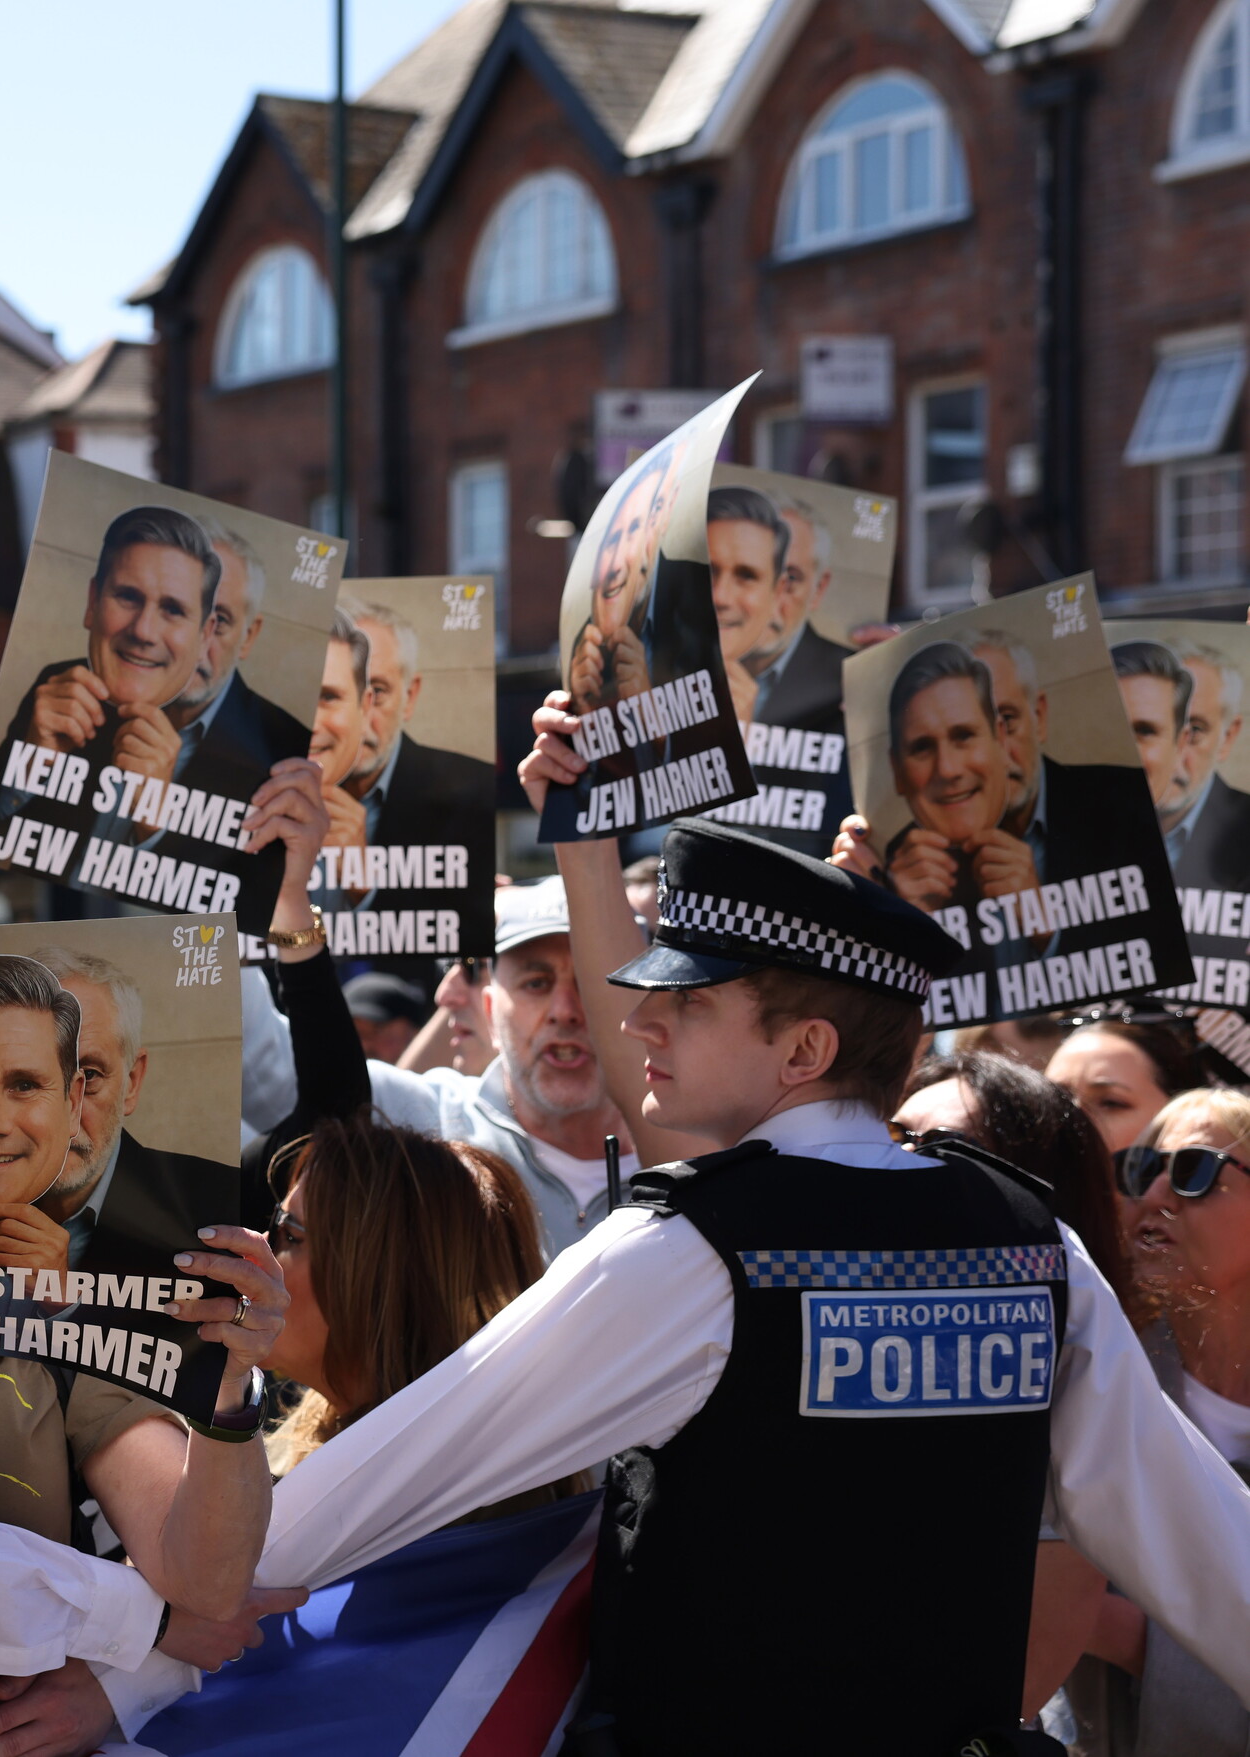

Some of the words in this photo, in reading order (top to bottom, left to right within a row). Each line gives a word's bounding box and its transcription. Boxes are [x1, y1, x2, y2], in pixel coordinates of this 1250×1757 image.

[299, 553, 329, 573] THE
[291, 566, 329, 589] HATE
[447, 599, 479, 616] THE
[1052, 603, 1082, 622] THE
[442, 614, 482, 631] HATE
[1052, 614, 1088, 640] HATE
[617, 669, 719, 748] STARMER
[738, 720, 845, 774] RMER
[2, 739, 90, 806] KEIR
[576, 776, 636, 834] JEW
[639, 747, 735, 820] HARMER
[78, 836, 240, 914] HARMER
[976, 864, 1150, 946] STARMER
[180, 946, 219, 966] THE
[176, 966, 223, 987] HATE
[997, 938, 1156, 1014] HARMER
[819, 1301, 1047, 1327] METROPOLITAN
[817, 1332, 1048, 1403] POLICE
